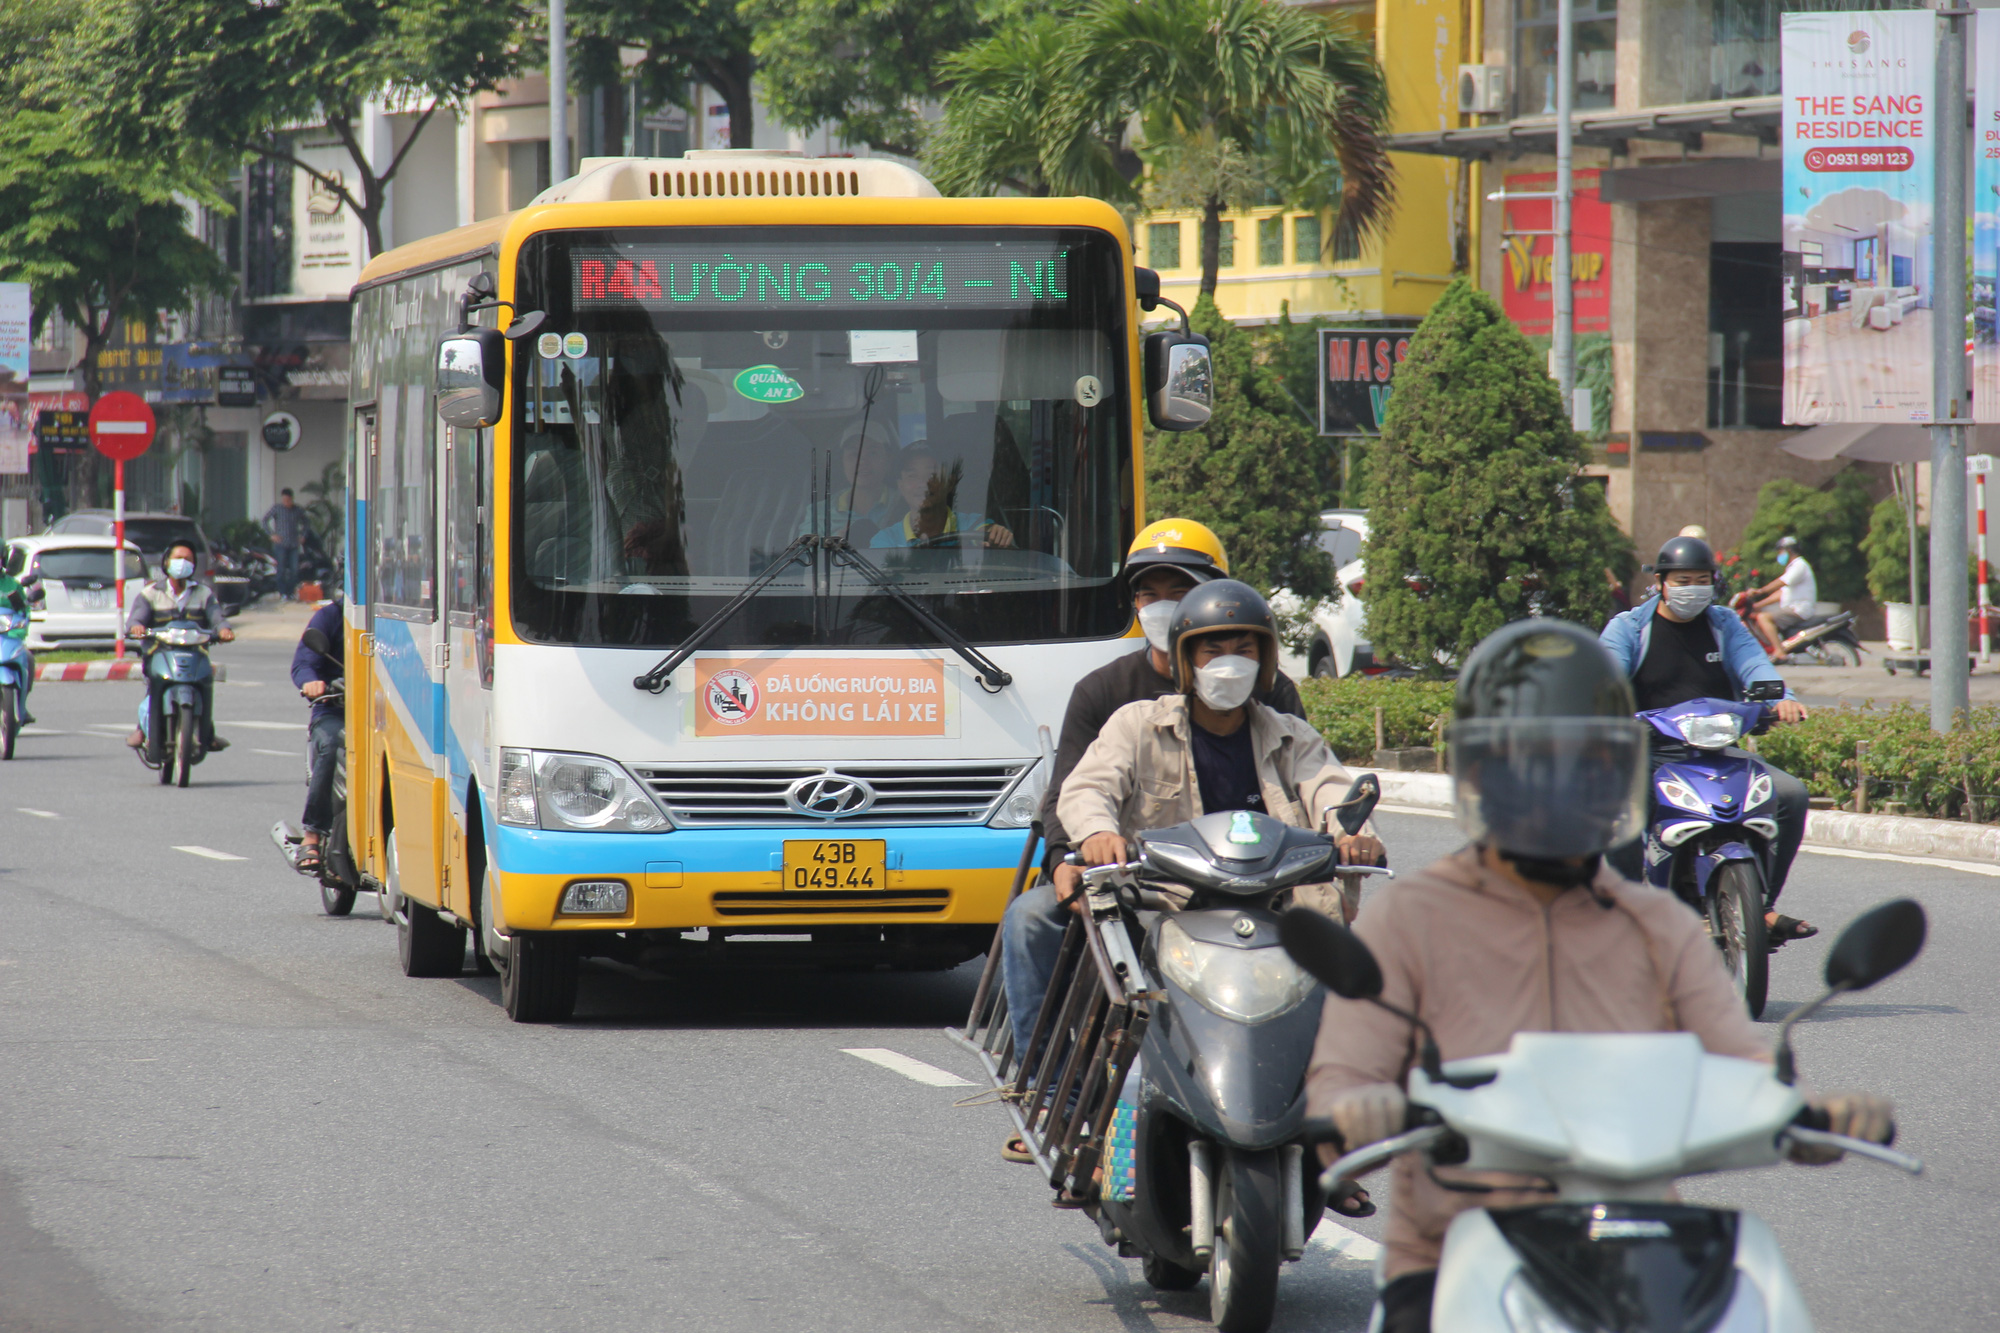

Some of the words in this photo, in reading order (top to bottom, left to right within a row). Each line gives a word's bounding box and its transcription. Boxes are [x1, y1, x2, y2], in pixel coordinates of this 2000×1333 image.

[1851, 58, 1907, 68] SANG
[1795, 96, 1845, 116] THE
[1852, 94, 1923, 115] SANG
[1796, 120, 1923, 139] RESIDENCE
[1827, 153, 1859, 166] 0931
[1861, 153, 1884, 165] 991
[1886, 152, 1908, 165] 123
[582, 260, 662, 299] R4A
[670, 253, 832, 301] ƯỜNG
[849, 262, 947, 301] 30/4
[763, 387, 784, 398] AN
[1151, 528, 1183, 541] yody
[766, 674, 793, 694] ĐÃ
[795, 672, 848, 694] UỐNG
[850, 675, 906, 698] RƯỢU,
[908, 677, 937, 694] BIA
[766, 699, 855, 722] KHÔNG
[863, 699, 900, 722] LÁI
[908, 703, 937, 722] XE
[812, 842, 856, 864] 43B
[794, 866, 874, 888] 049.44
